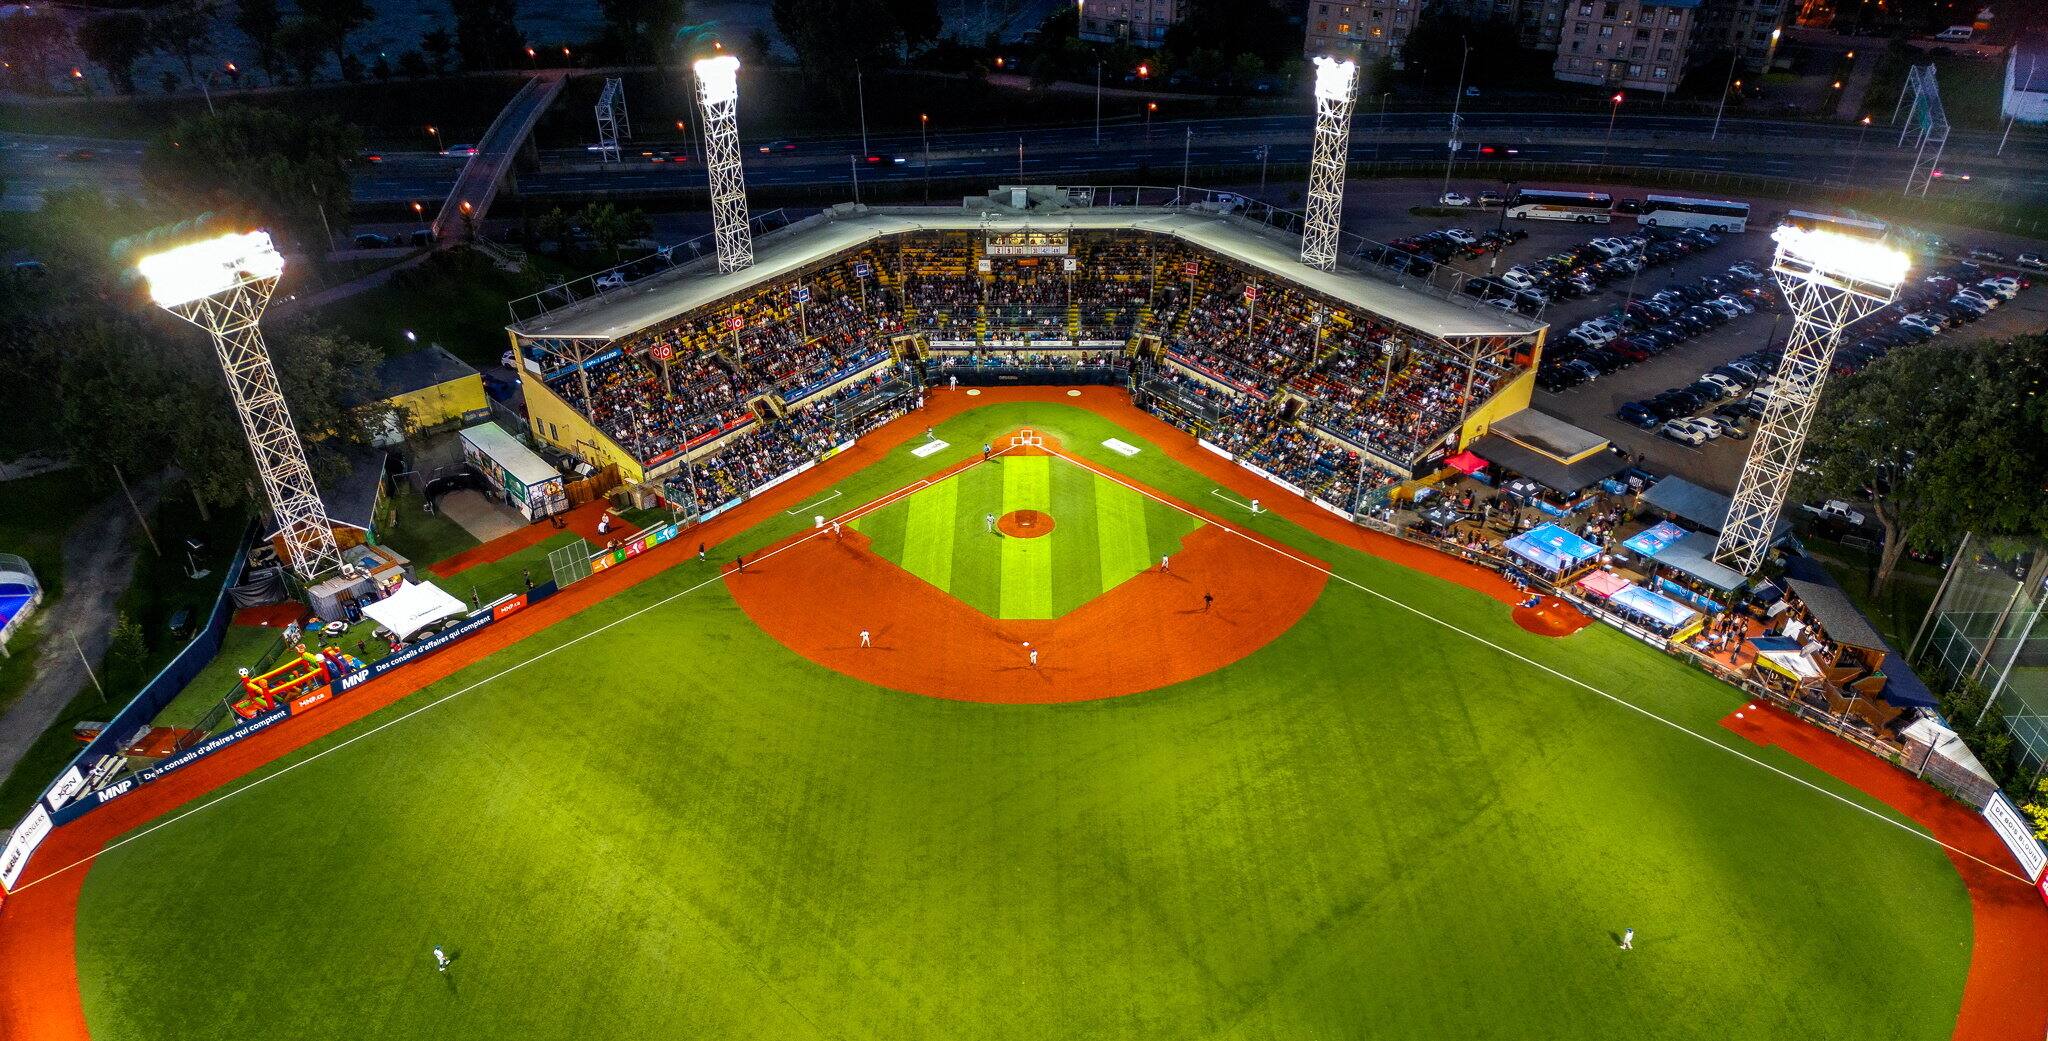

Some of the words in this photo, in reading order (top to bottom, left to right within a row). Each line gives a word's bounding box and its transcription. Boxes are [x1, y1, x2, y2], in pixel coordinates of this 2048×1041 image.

[501, 600, 521, 613] MNP.ca
[342, 669, 370, 690] MNP
[375, 662, 391, 672] Des
[390, 649, 419, 668] conseils
[418, 635, 449, 653] d'affaires
[449, 628, 460, 639] qui
[460, 615, 492, 635] comptent
[298, 692, 325, 708] MNP.ca
[98, 779, 132, 803] MNP
[144, 767, 164, 780] Des
[164, 753, 198, 771] conseils
[197, 734, 235, 755] d'affaires
[235, 726, 250, 738] qui
[249, 709, 287, 732] comptent
[1995, 806, 2004, 817] DE
[24, 814, 46, 838] ROGERS
